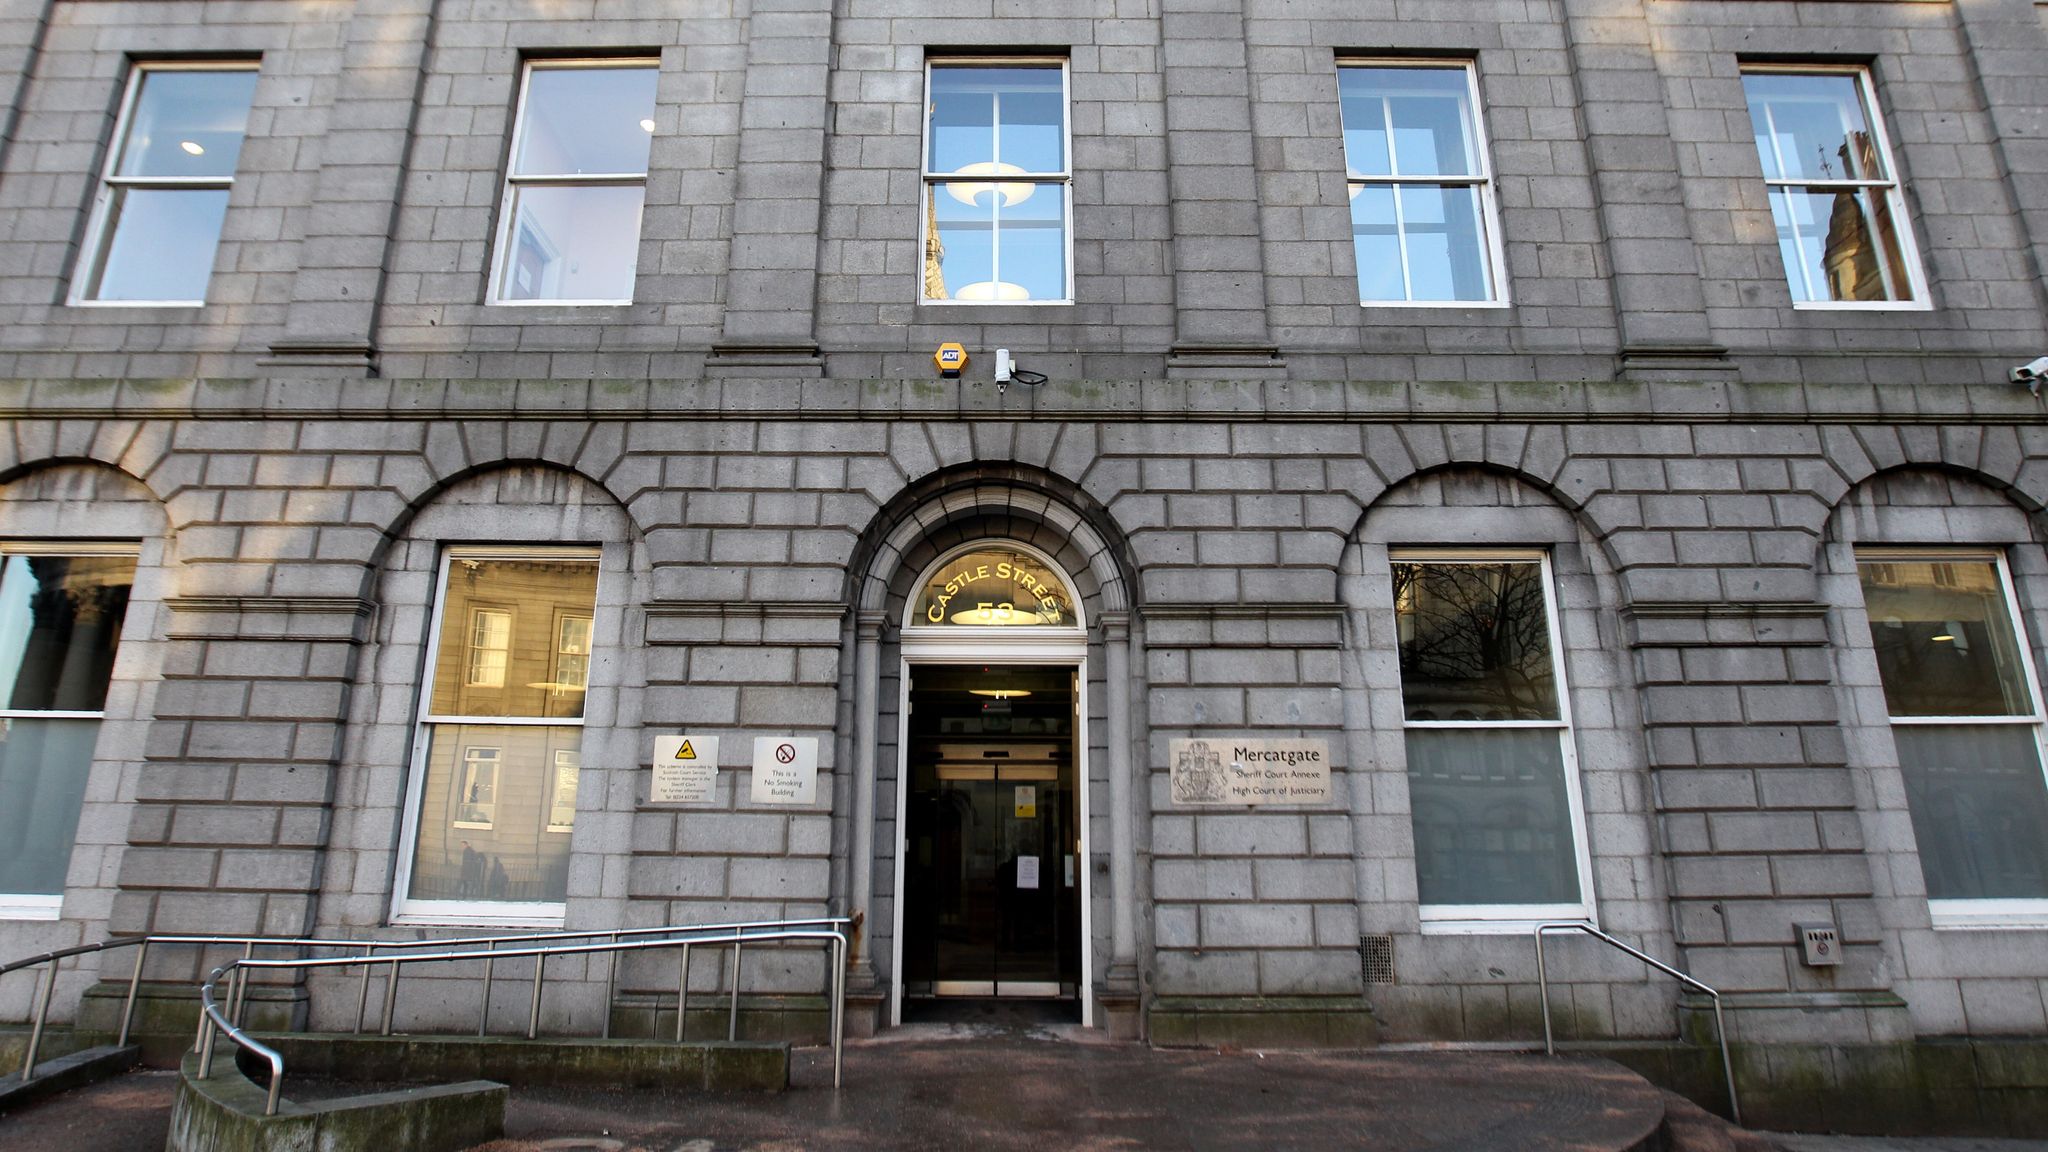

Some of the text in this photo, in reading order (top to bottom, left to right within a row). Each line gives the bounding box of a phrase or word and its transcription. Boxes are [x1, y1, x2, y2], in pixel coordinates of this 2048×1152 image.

[942, 351, 959, 360] ADT
[928, 562, 1061, 623] CASTLE STREET
[977, 602, 1014, 621] 53
[1234, 747, 1320, 766] Mercatgate
[1236, 770, 1321, 779] Sheriff Court Annexe
[776, 779, 803, 788] Smoking
[771, 789, 795, 797] Building
[1232, 786, 1326, 797] High Court of Justiciary
